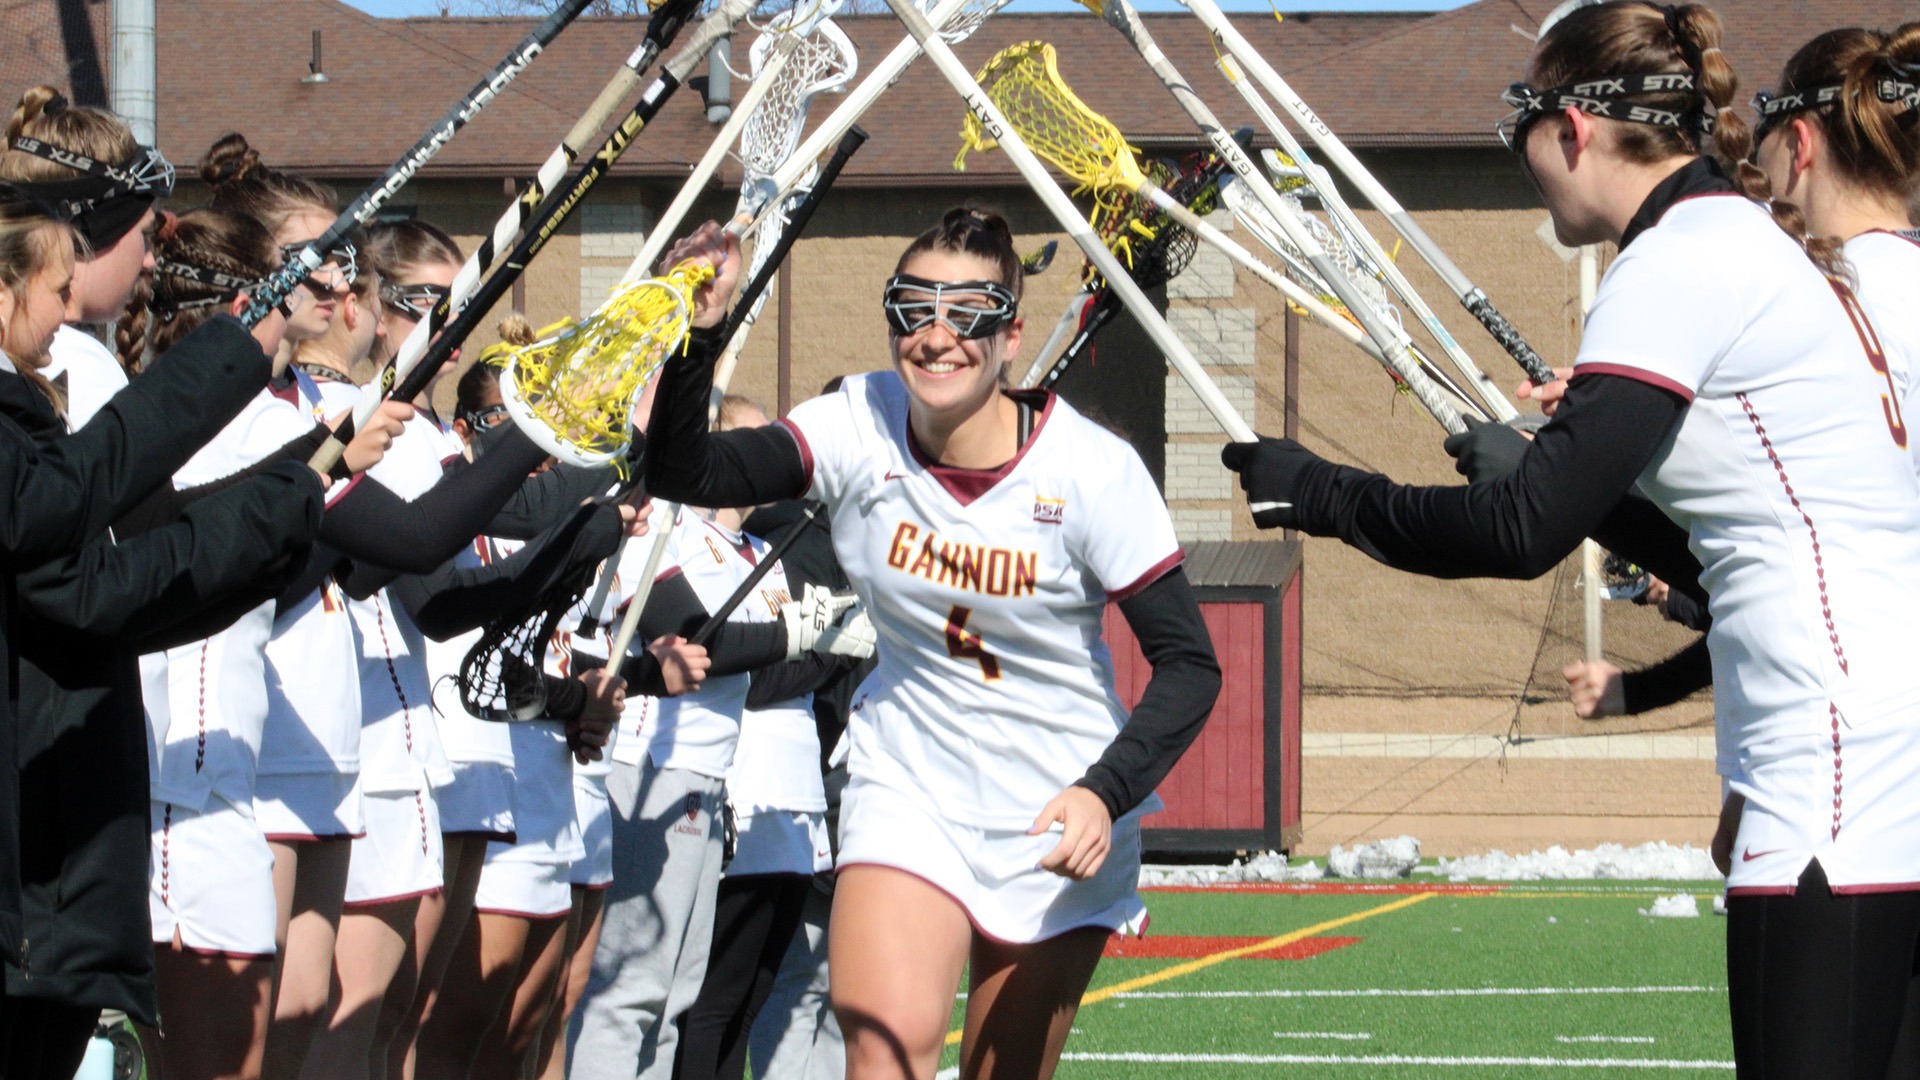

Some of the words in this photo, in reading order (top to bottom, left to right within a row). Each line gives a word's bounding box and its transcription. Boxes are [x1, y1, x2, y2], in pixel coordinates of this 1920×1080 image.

[459, 42, 543, 123] UNDER
[1573, 77, 1626, 97] STX
[1642, 74, 1694, 91] STX
[962, 93, 1003, 140] GAIT
[1292, 100, 1330, 137] GAIT
[1557, 95, 1613, 116] STX
[1628, 105, 1682, 127] STX
[1763, 93, 1805, 115] STX
[596, 109, 645, 167] STX
[1214, 135, 1252, 176] GAIT
[49, 147, 94, 171] STX
[353, 120, 455, 224] ARMOUR
[538, 166, 600, 240] FORTRESS
[887, 520, 1038, 598] GANNON
[815, 596, 828, 633] STX
[944, 603, 1003, 684] 4
